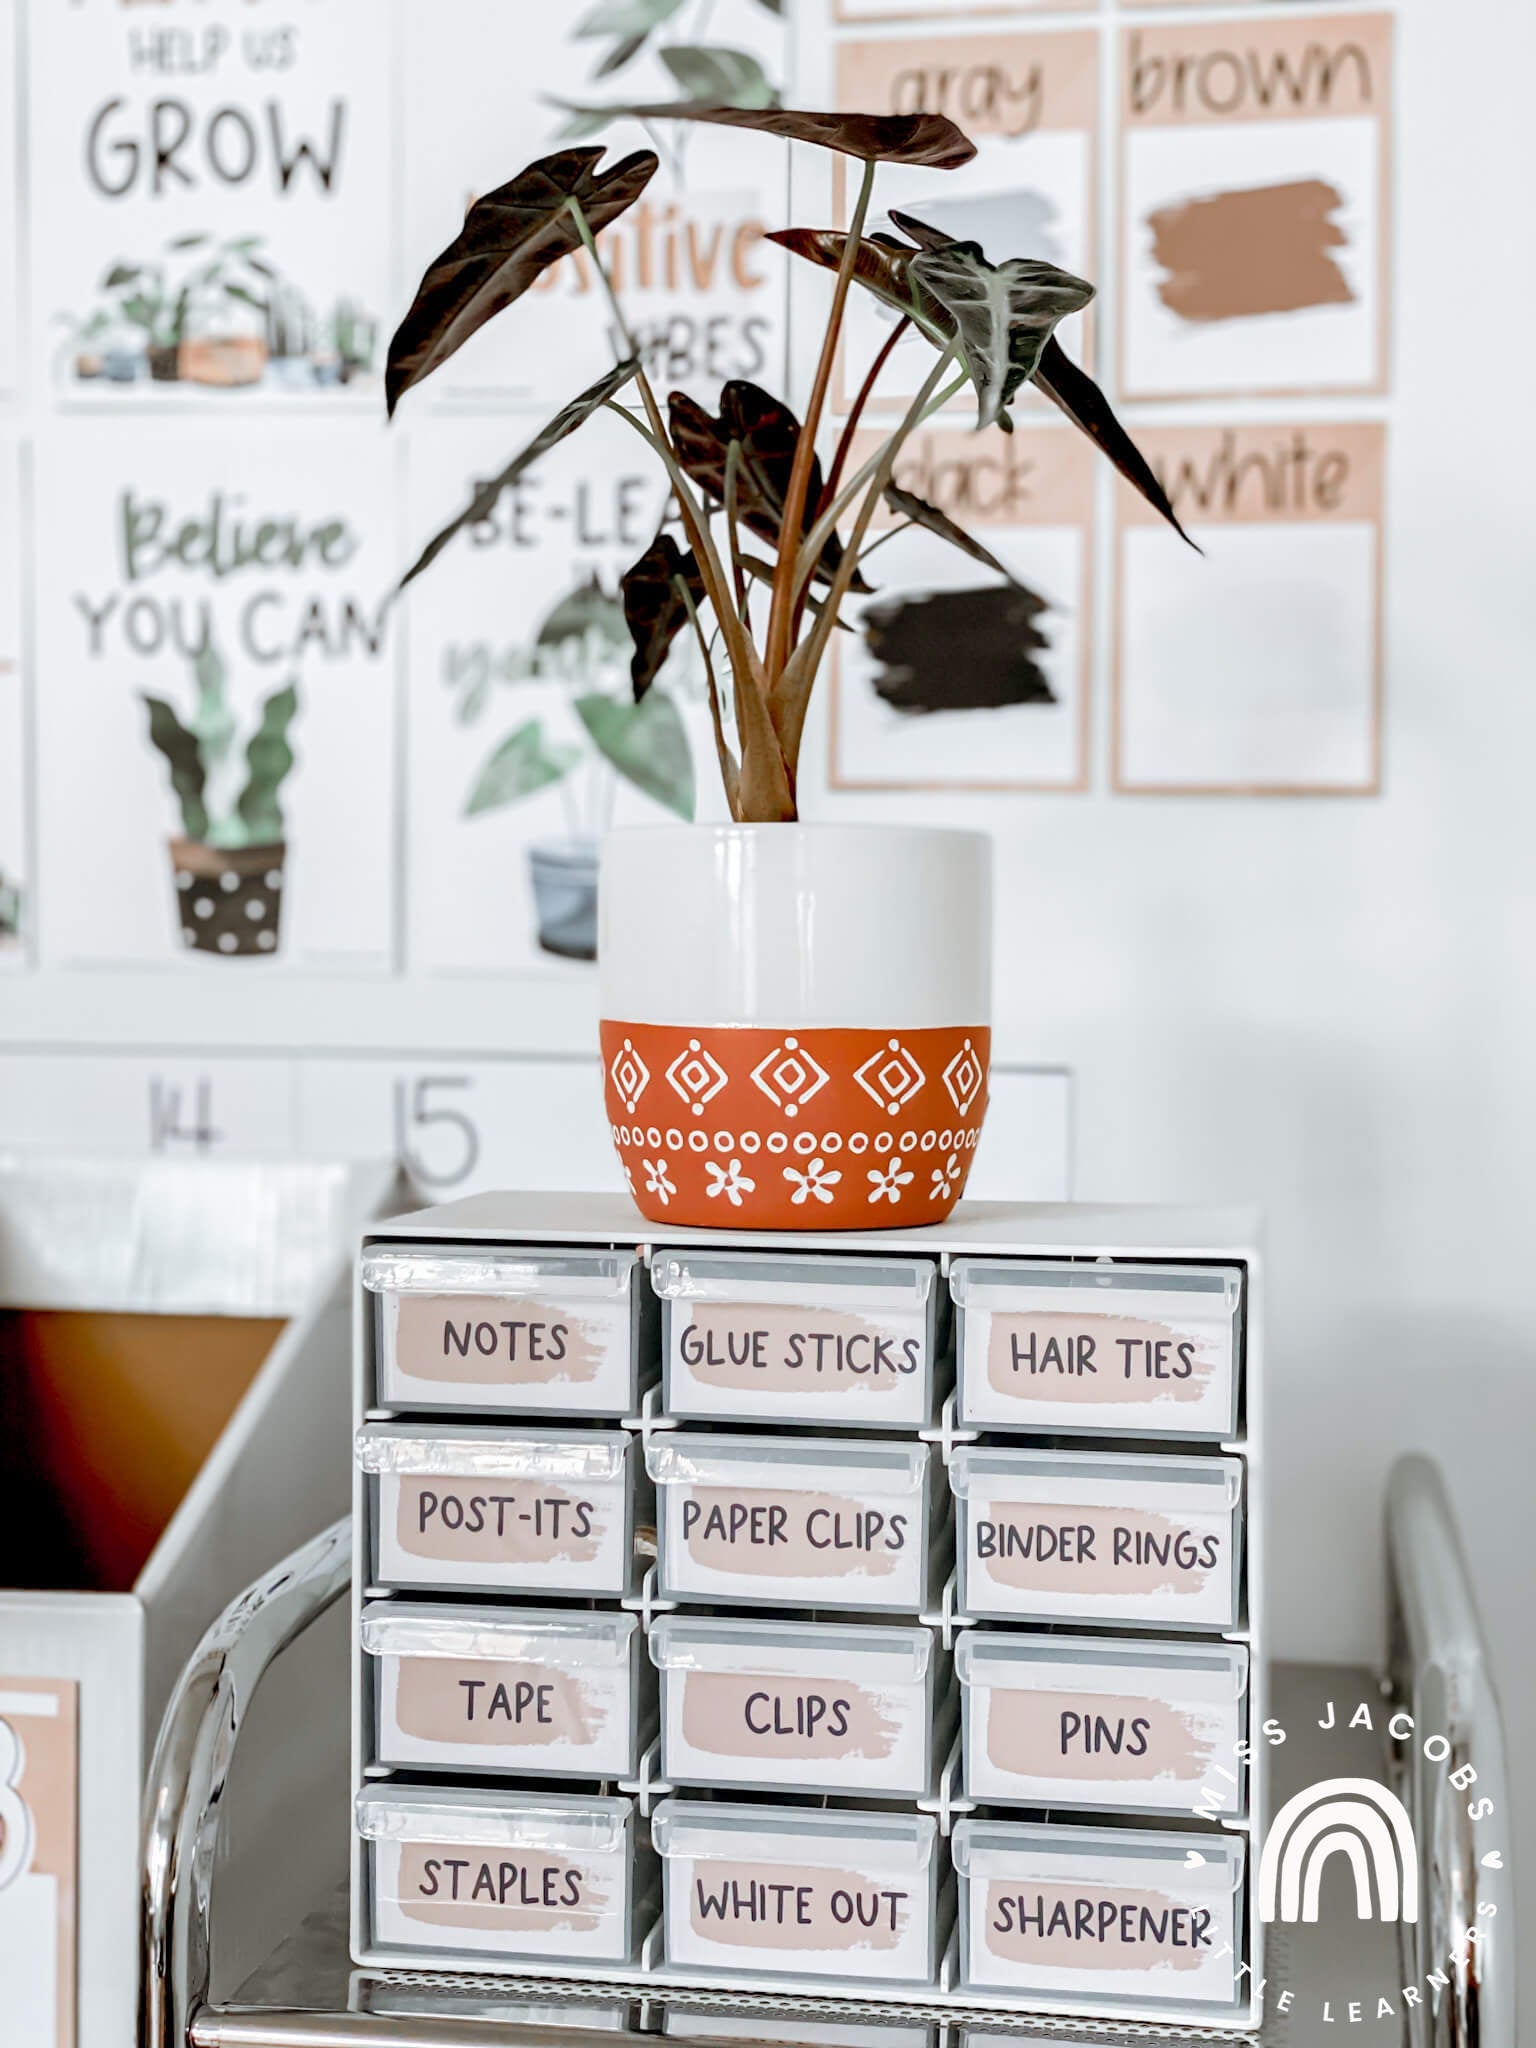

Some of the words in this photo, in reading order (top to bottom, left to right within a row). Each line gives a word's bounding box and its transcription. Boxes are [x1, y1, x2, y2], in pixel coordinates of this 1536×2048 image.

[128, 23, 231, 75] HELP
[242, 24, 297, 71] US
[1128, 30, 1373, 114] brown
[86, 96, 347, 197] GROW
[1152, 428, 1350, 512] white
[117, 485, 357, 582] Believe
[74, 590, 213, 660] YOU
[240, 590, 392, 664] CAN
[147, 1074, 221, 1154] 14
[393, 1075, 481, 1187] 15
[444, 1320, 568, 1361] NOTES
[681, 1325, 768, 1367] GLUE
[784, 1334, 919, 1374] STICKS
[1012, 1332, 1097, 1376] HAIR
[1116, 1338, 1195, 1379] TIES
[419, 1491, 594, 1540] POST-ITS
[684, 1500, 788, 1545] PAPER
[806, 1508, 907, 1551] CLIPS
[977, 1521, 1096, 1563] BINDER
[1113, 1528, 1220, 1570] RINGS
[459, 1680, 554, 1724] TAPE
[745, 1692, 851, 1738] CLIPS
[1061, 1711, 1151, 1756] PINS
[419, 1859, 583, 1906] STAPLES
[697, 1878, 813, 1925] WHITE
[831, 1889, 908, 1931] OUT
[993, 1896, 1212, 1948] SHARPENER
